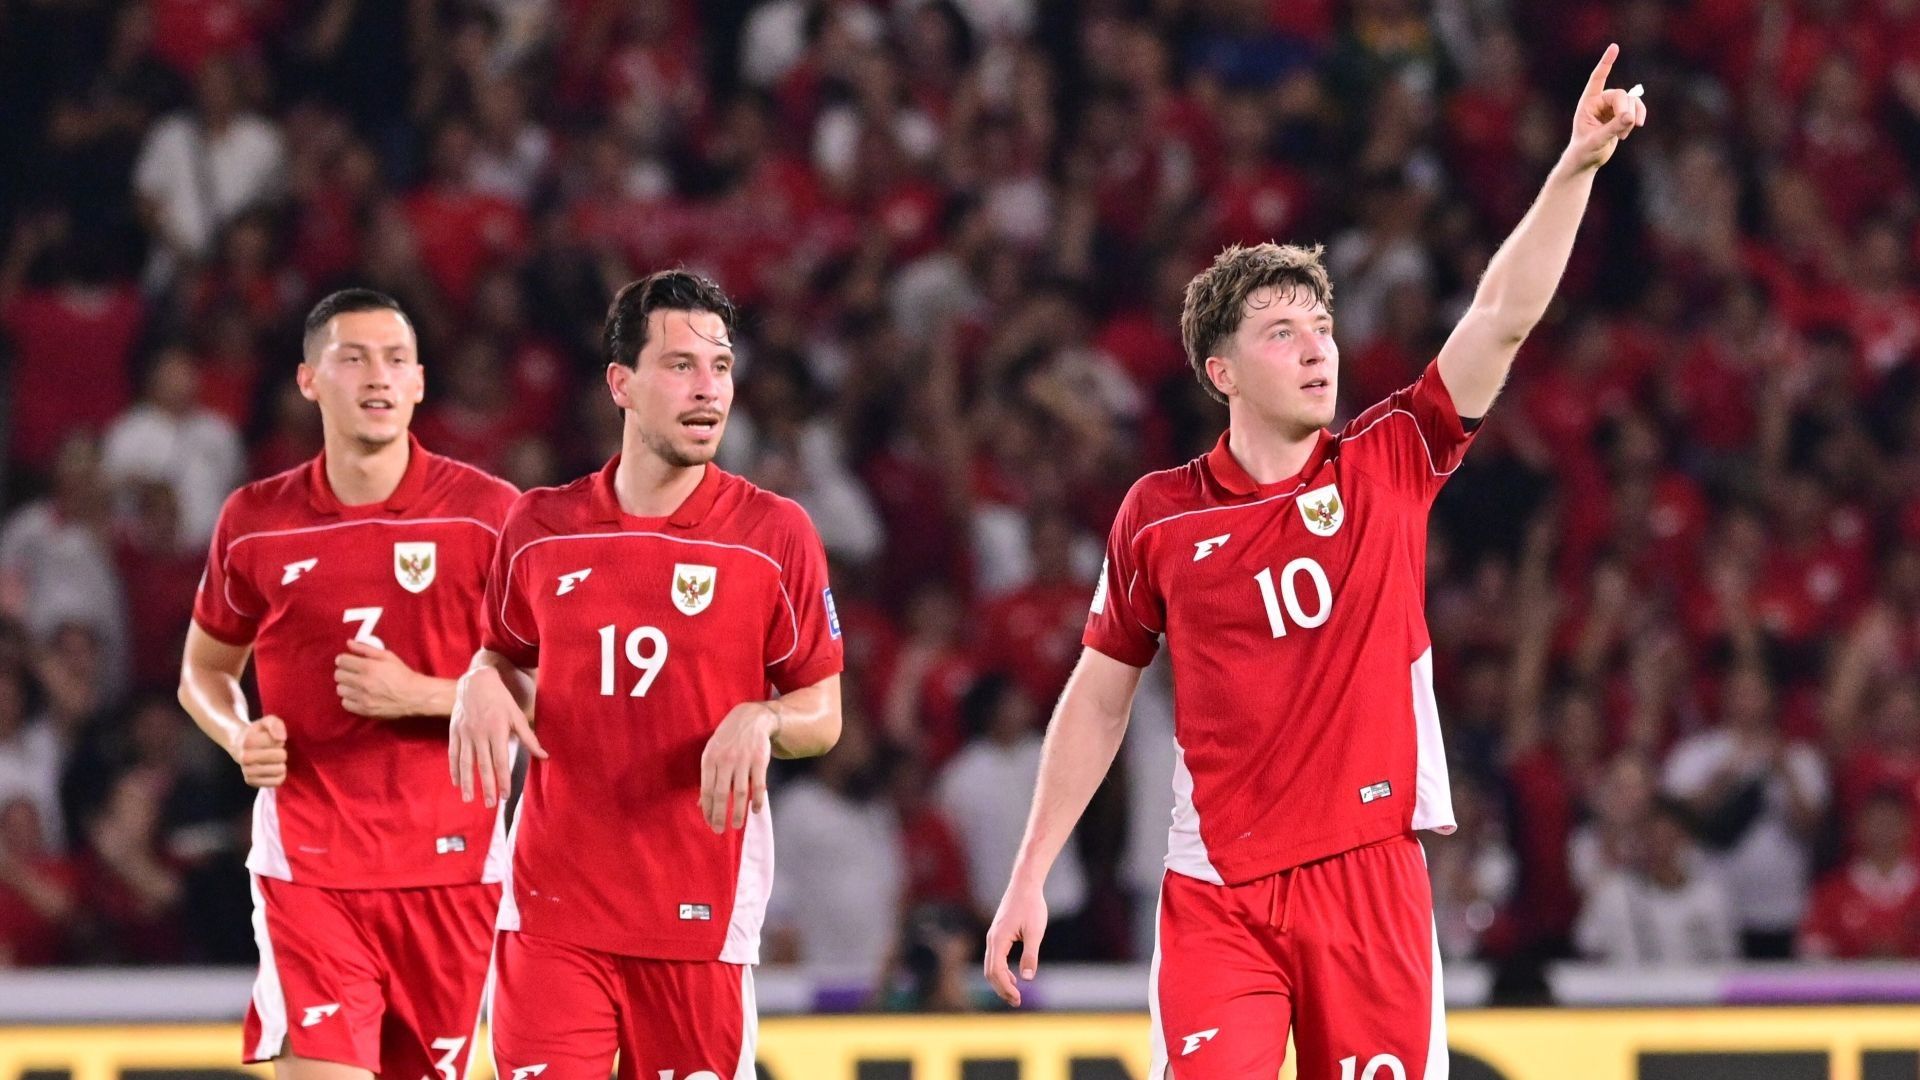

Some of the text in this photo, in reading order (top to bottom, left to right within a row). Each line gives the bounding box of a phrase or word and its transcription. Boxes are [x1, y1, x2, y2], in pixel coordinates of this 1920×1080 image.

[342, 606, 386, 651] 3
[1253, 556, 1333, 640] 10
[597, 624, 669, 698] 19
